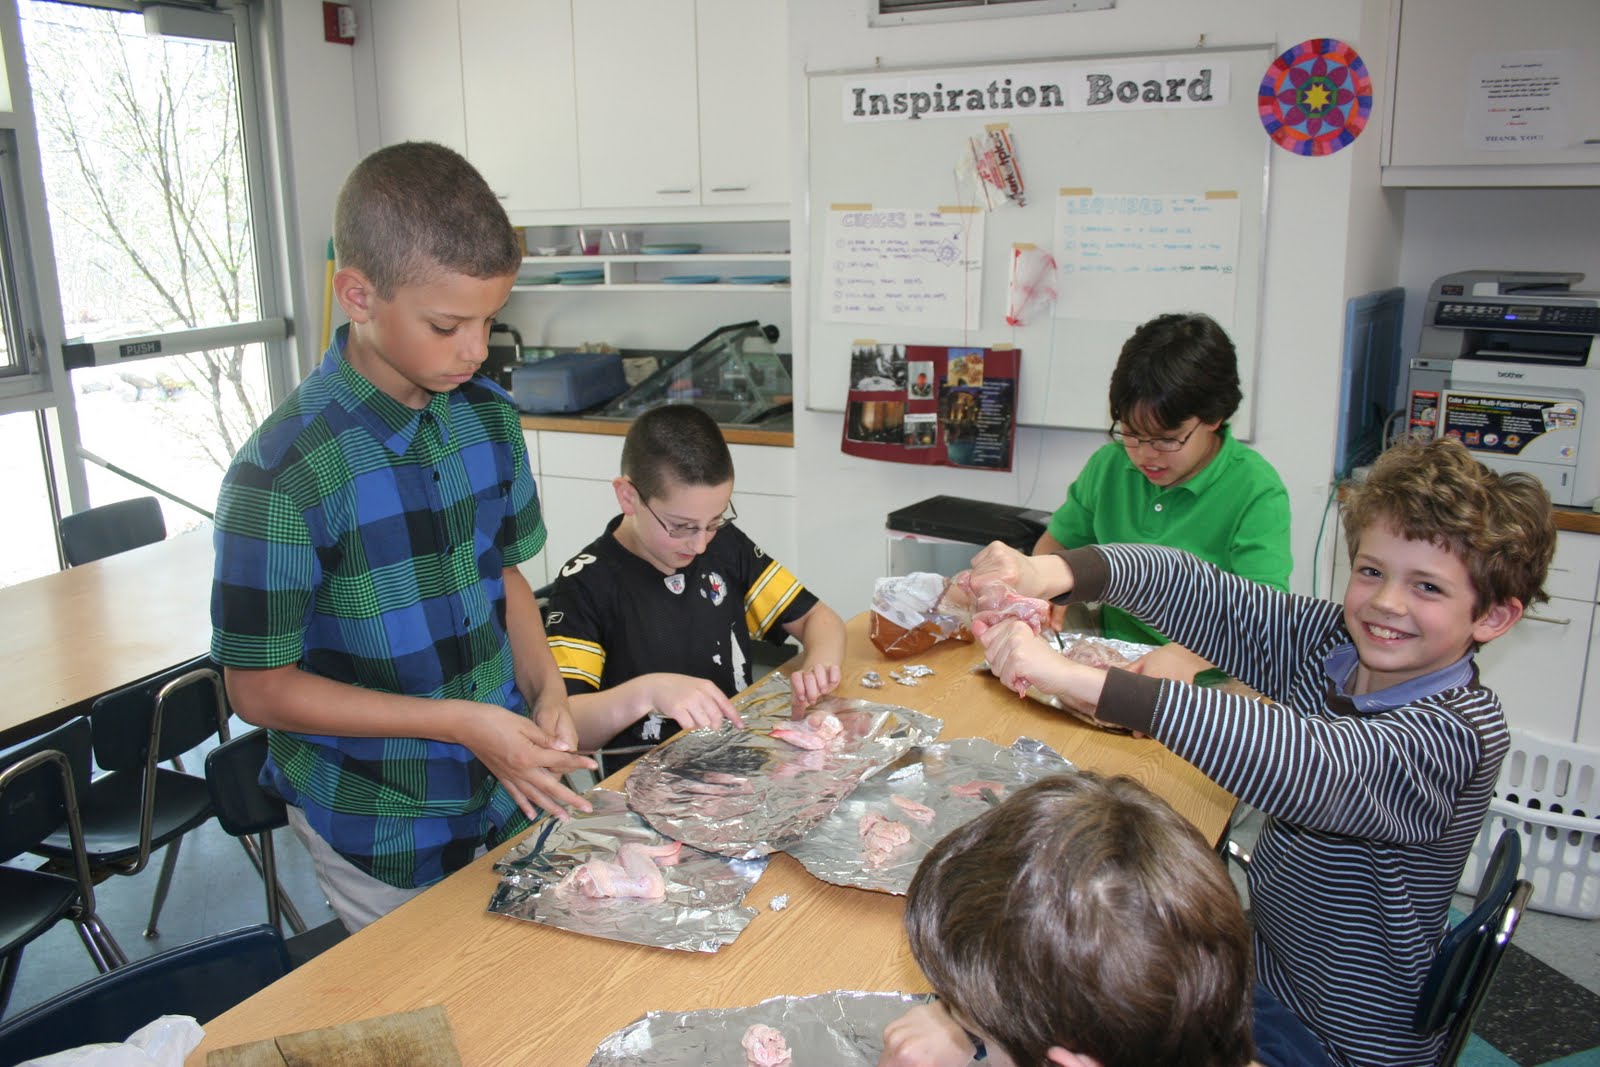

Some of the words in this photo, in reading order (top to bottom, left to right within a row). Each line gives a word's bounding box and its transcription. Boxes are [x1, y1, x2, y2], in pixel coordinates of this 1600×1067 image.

[852, 80, 1064, 119] Inspiration
[1086, 69, 1213, 106] Board
[126, 343, 155, 355] PUSH
[1497, 371, 1525, 379] brother
[1448, 396, 1463, 404] Color
[1463, 397, 1479, 405] Laser
[1480, 398, 1521, 408] Multi-Function
[561, 553, 597, 578] 3
